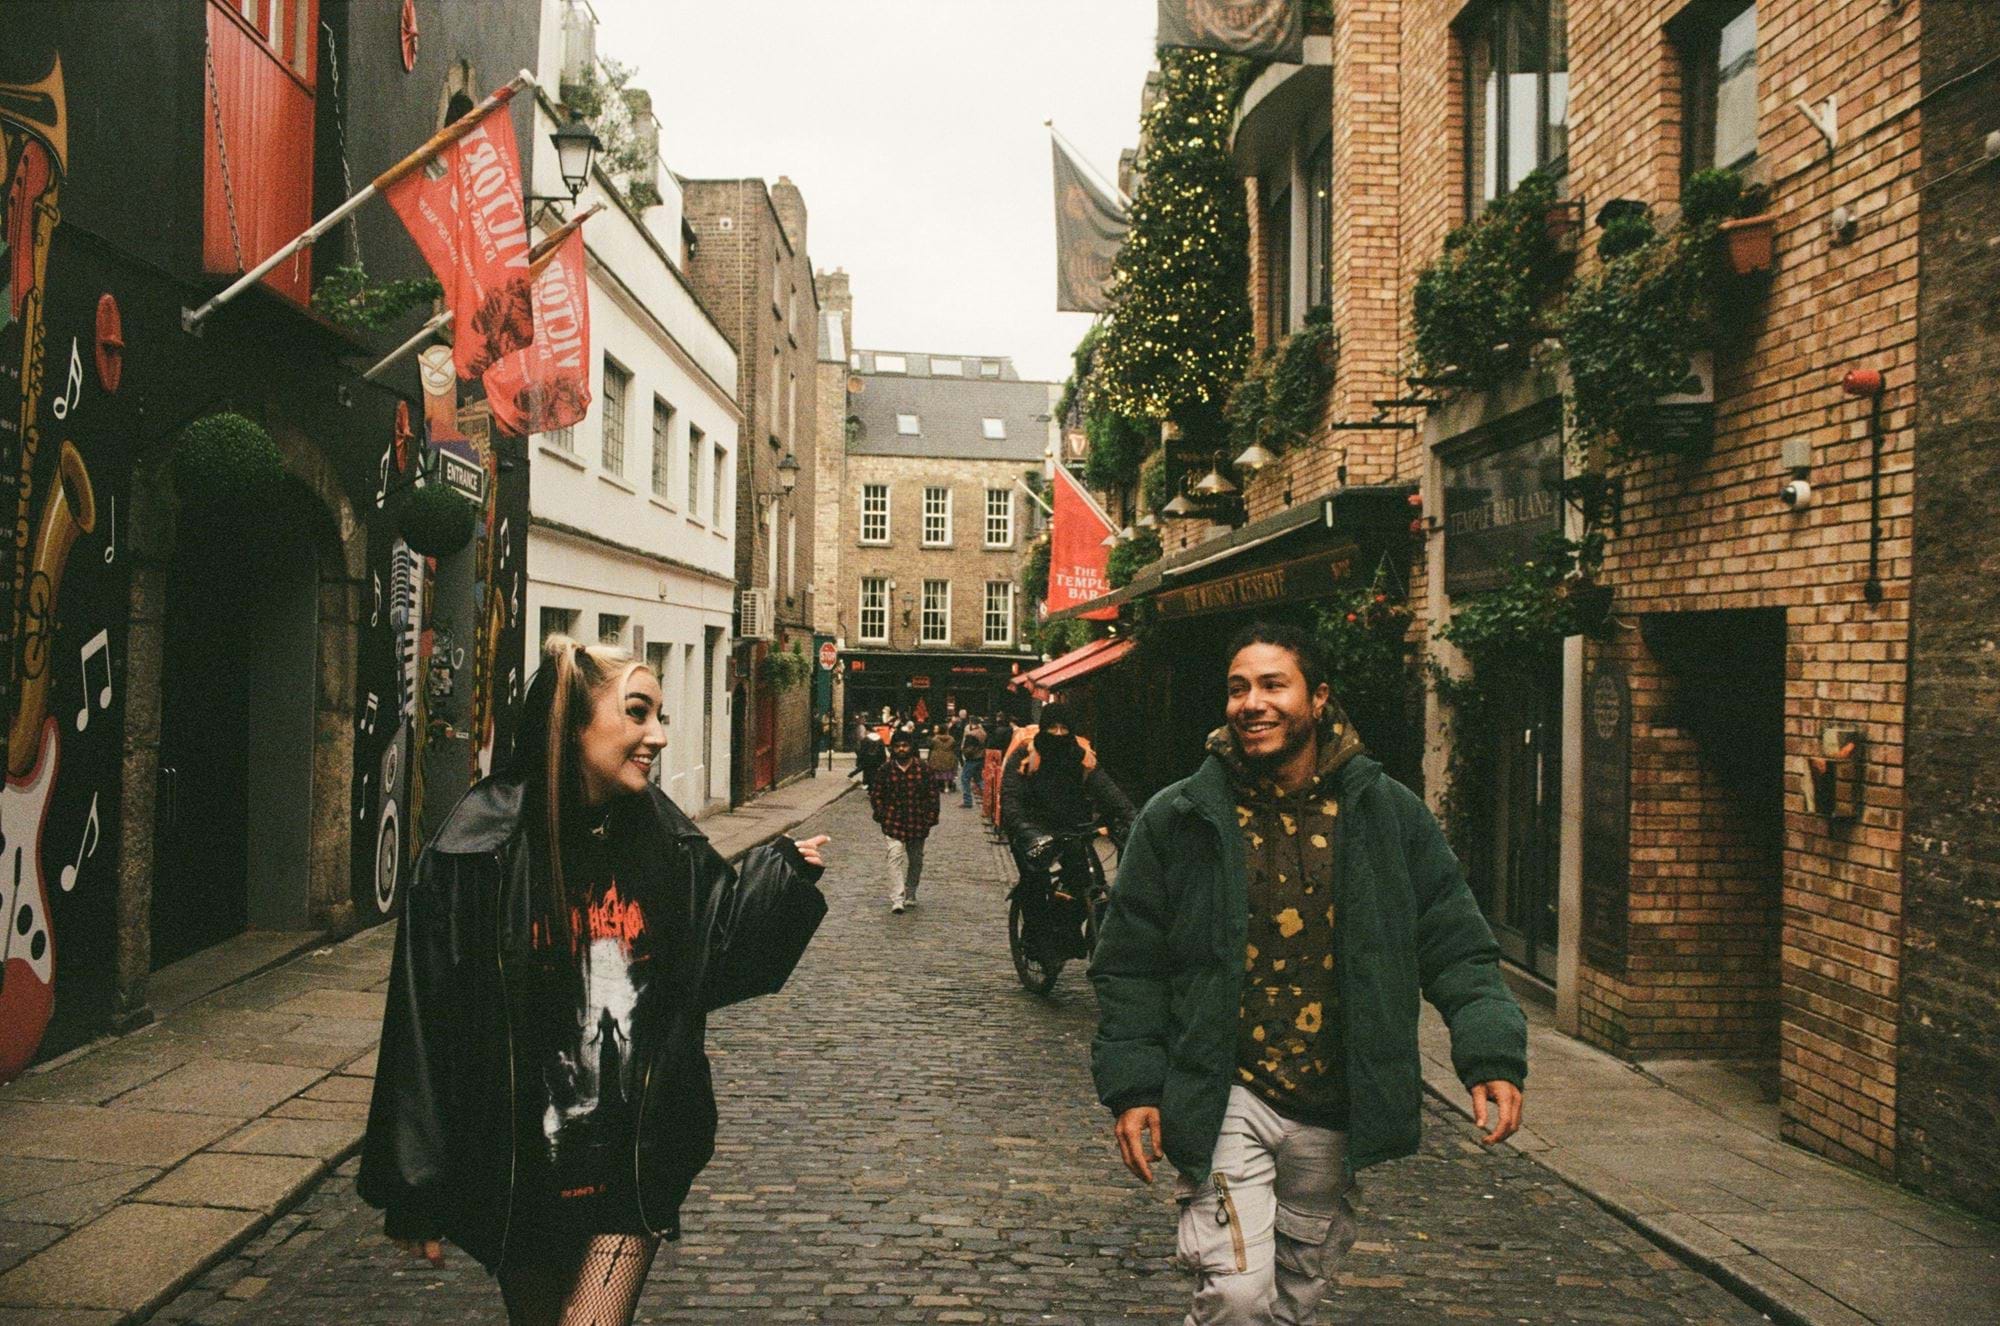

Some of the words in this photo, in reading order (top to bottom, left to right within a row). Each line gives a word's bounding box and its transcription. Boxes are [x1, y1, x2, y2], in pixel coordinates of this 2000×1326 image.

[447, 461, 478, 492] ENTRANCE
[1073, 565, 1097, 578] THE
[1068, 587, 1099, 601] BAR
[820, 651, 836, 663] STOP
